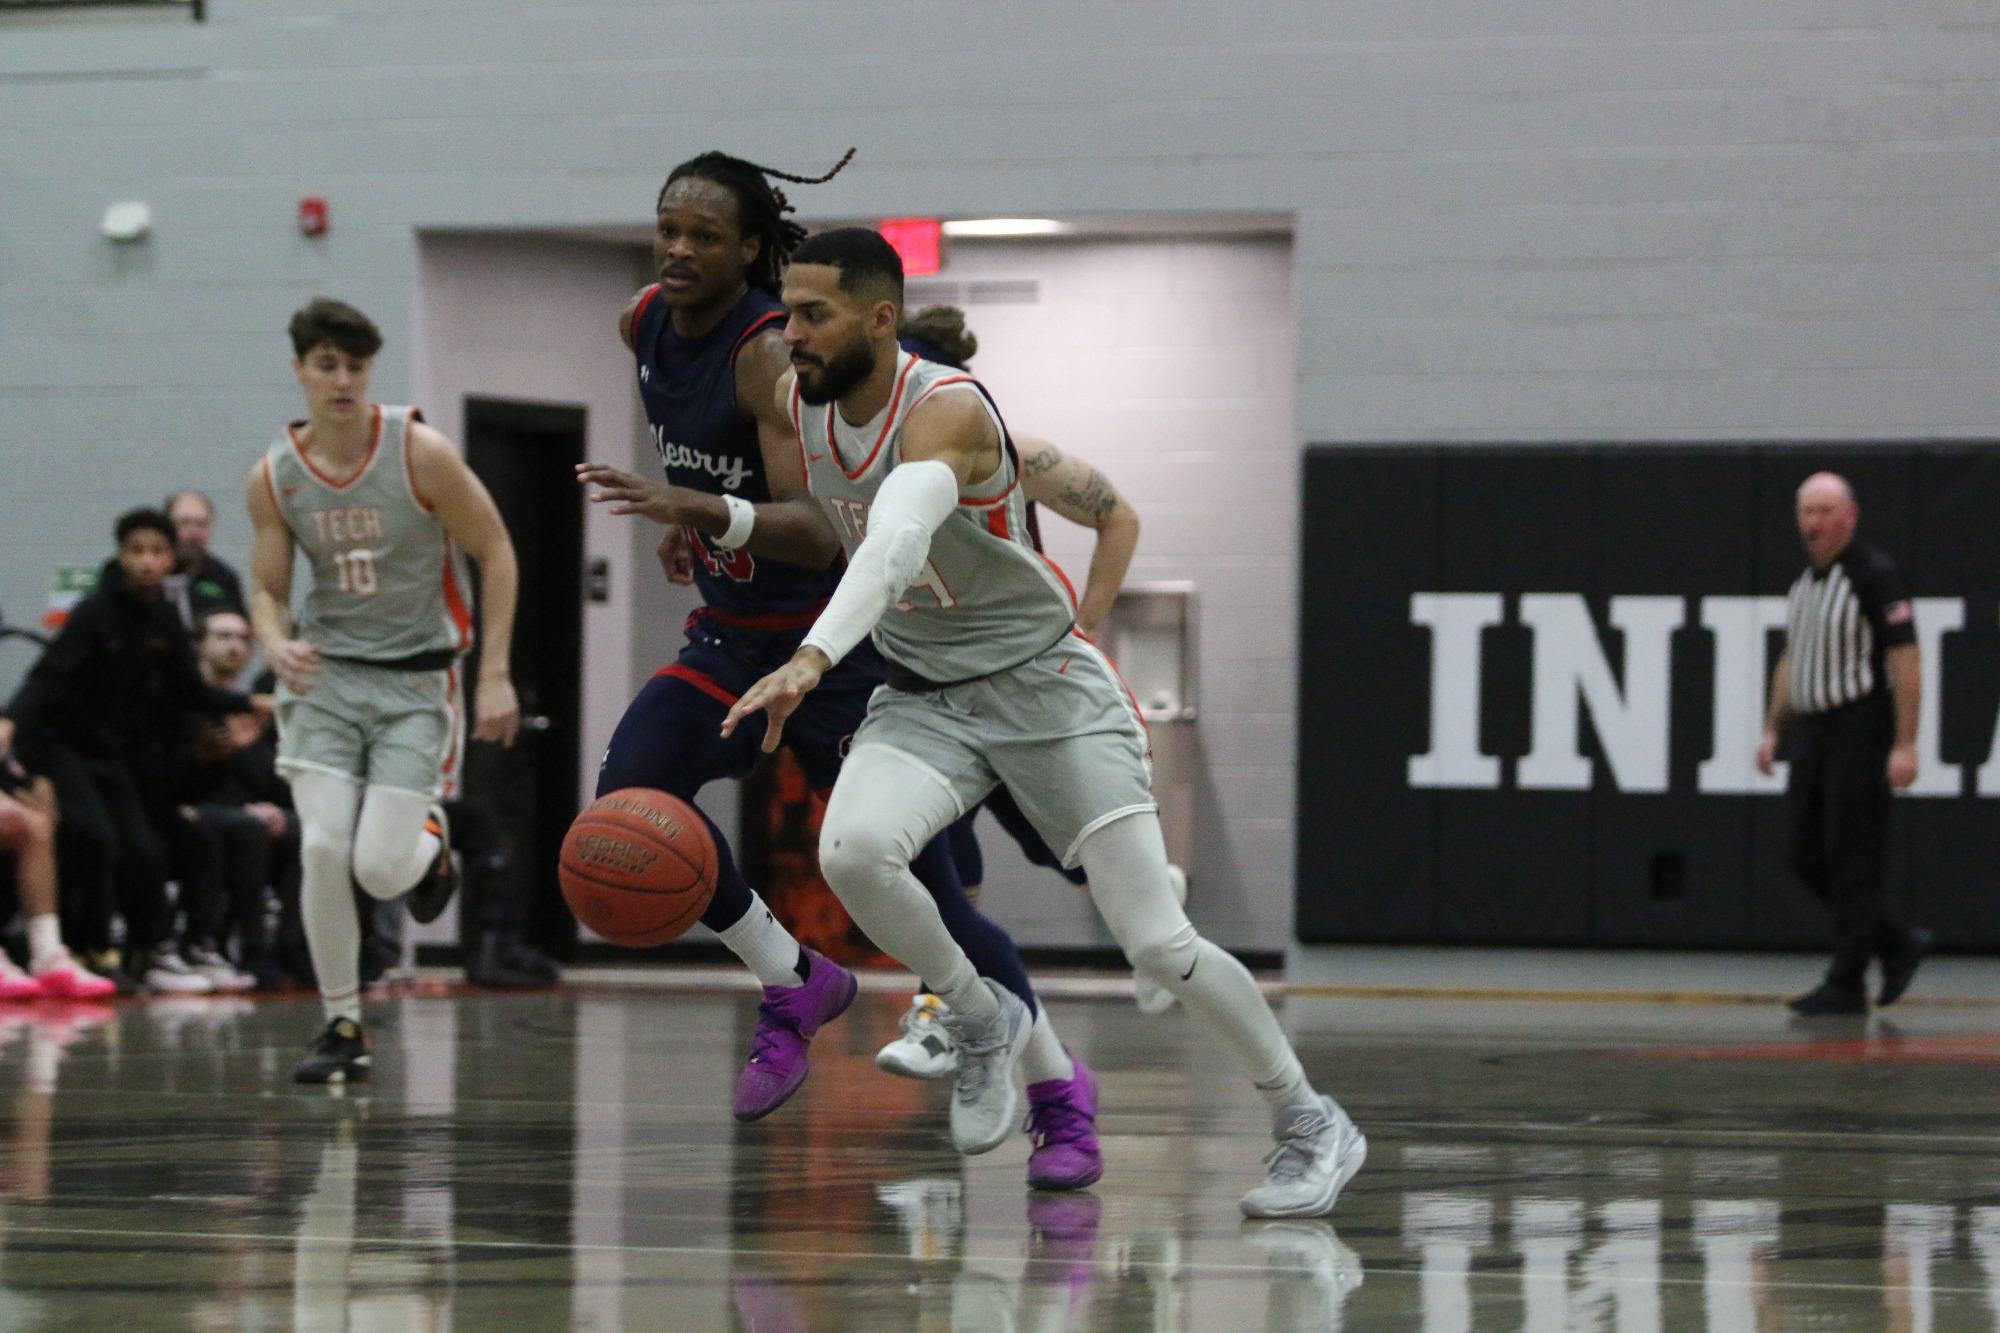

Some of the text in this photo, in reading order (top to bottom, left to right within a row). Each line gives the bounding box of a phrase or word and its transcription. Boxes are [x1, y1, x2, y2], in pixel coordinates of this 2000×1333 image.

[650, 423, 753, 490] leary
[829, 496, 873, 541] TE
[333, 548, 378, 595] 10
